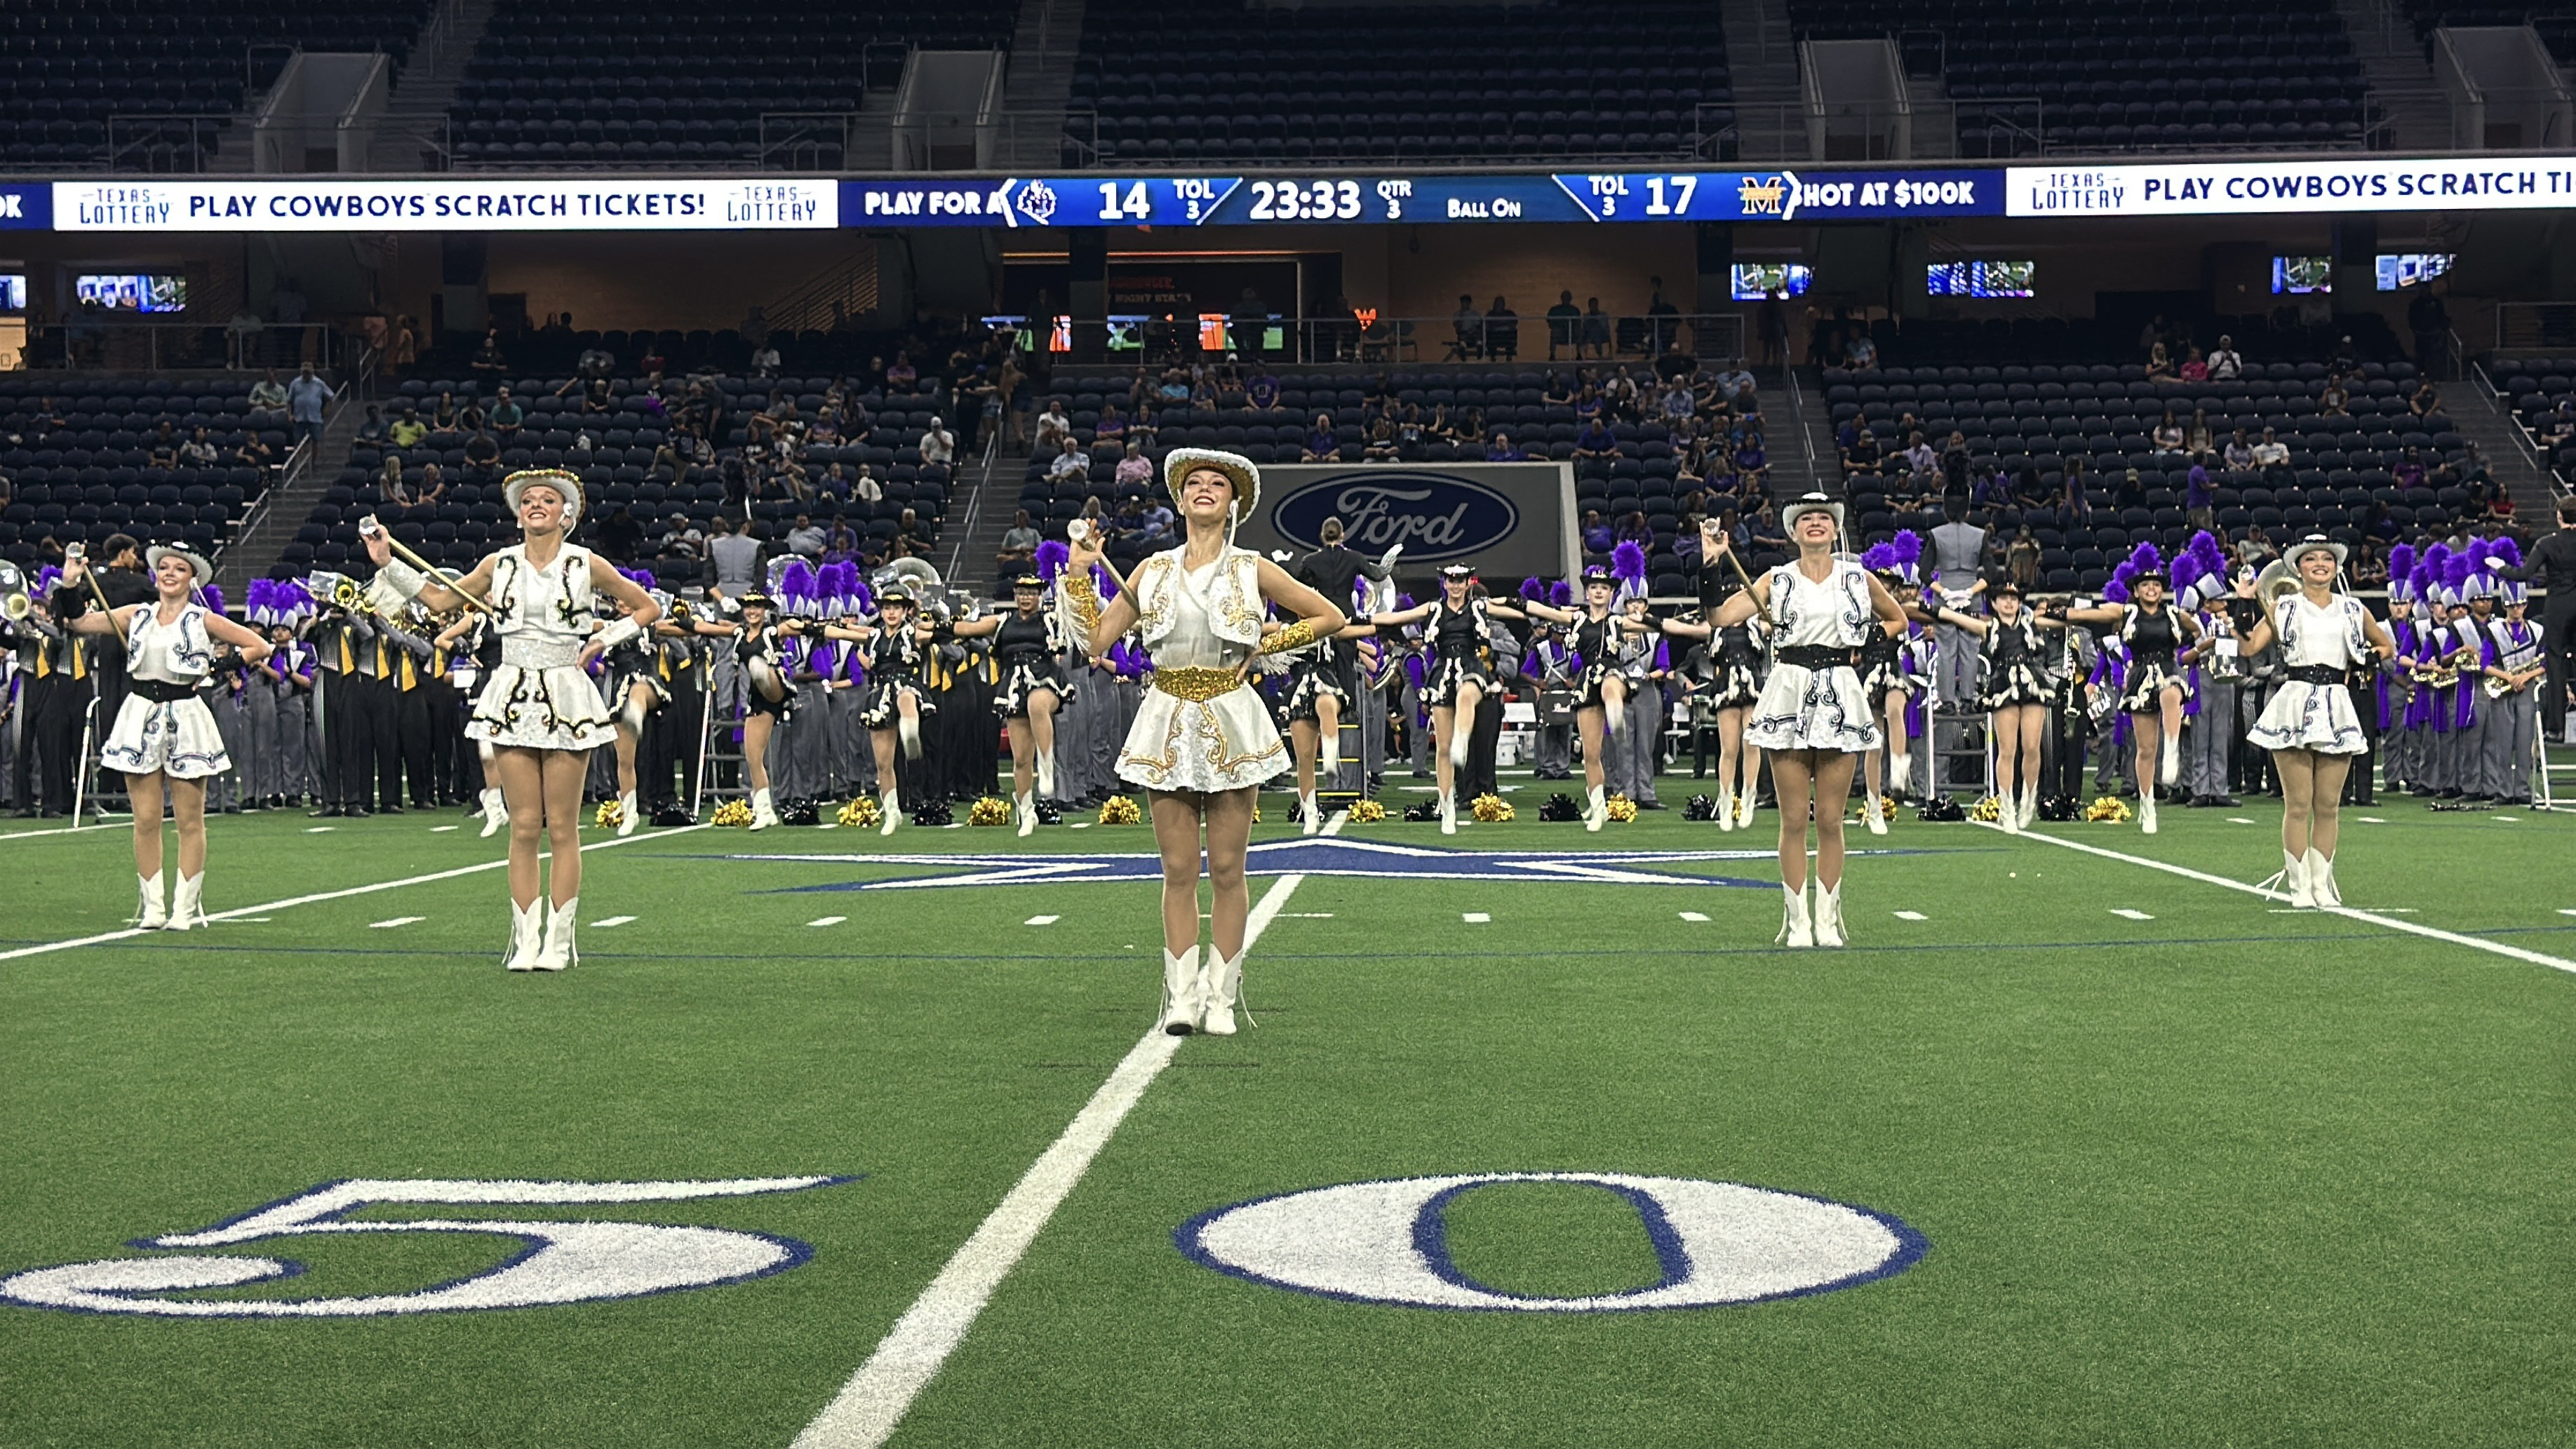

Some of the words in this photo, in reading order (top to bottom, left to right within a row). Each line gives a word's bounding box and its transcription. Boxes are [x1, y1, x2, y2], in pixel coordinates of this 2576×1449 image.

[1173, 179, 1216, 199] TOL
[1376, 180, 1412, 198] QTR
[1588, 175, 1629, 196] TOL
[2051, 173, 2105, 187] TEXAS
[2145, 177, 2214, 201] PLAY
[2225, 174, 2387, 199] COWBOYS
[2397, 172, 2535, 196] SCRATCH
[97, 189, 150, 203] TEXAS
[744, 187, 798, 201] TEXAS
[865, 191, 924, 215] PLAY
[929, 191, 981, 215] FOR
[1099, 181, 1151, 220] 14
[1249, 180, 1361, 220] 23:33
[1646, 176, 1698, 215] 17
[1859, 182, 1889, 206] AT
[1894, 179, 1975, 208] $100K
[2032, 187, 2124, 210] LOTTERY
[80, 202, 170, 224] LOTTERY
[189, 195, 257, 217] PLAY
[269, 194, 424, 217] COWBOYS
[435, 194, 566, 217] SCRATCH
[577, 194, 704, 216] TICKETS!
[727, 201, 816, 222] LOTTERY
[1186, 200, 1200, 220] 3
[1386, 198, 1402, 219] 3
[1602, 196, 1616, 216] 3
[1336, 485, 1469, 546] Ford
[0, 1177, 859, 1317] 5
[1175, 1171, 1929, 1312] 0
